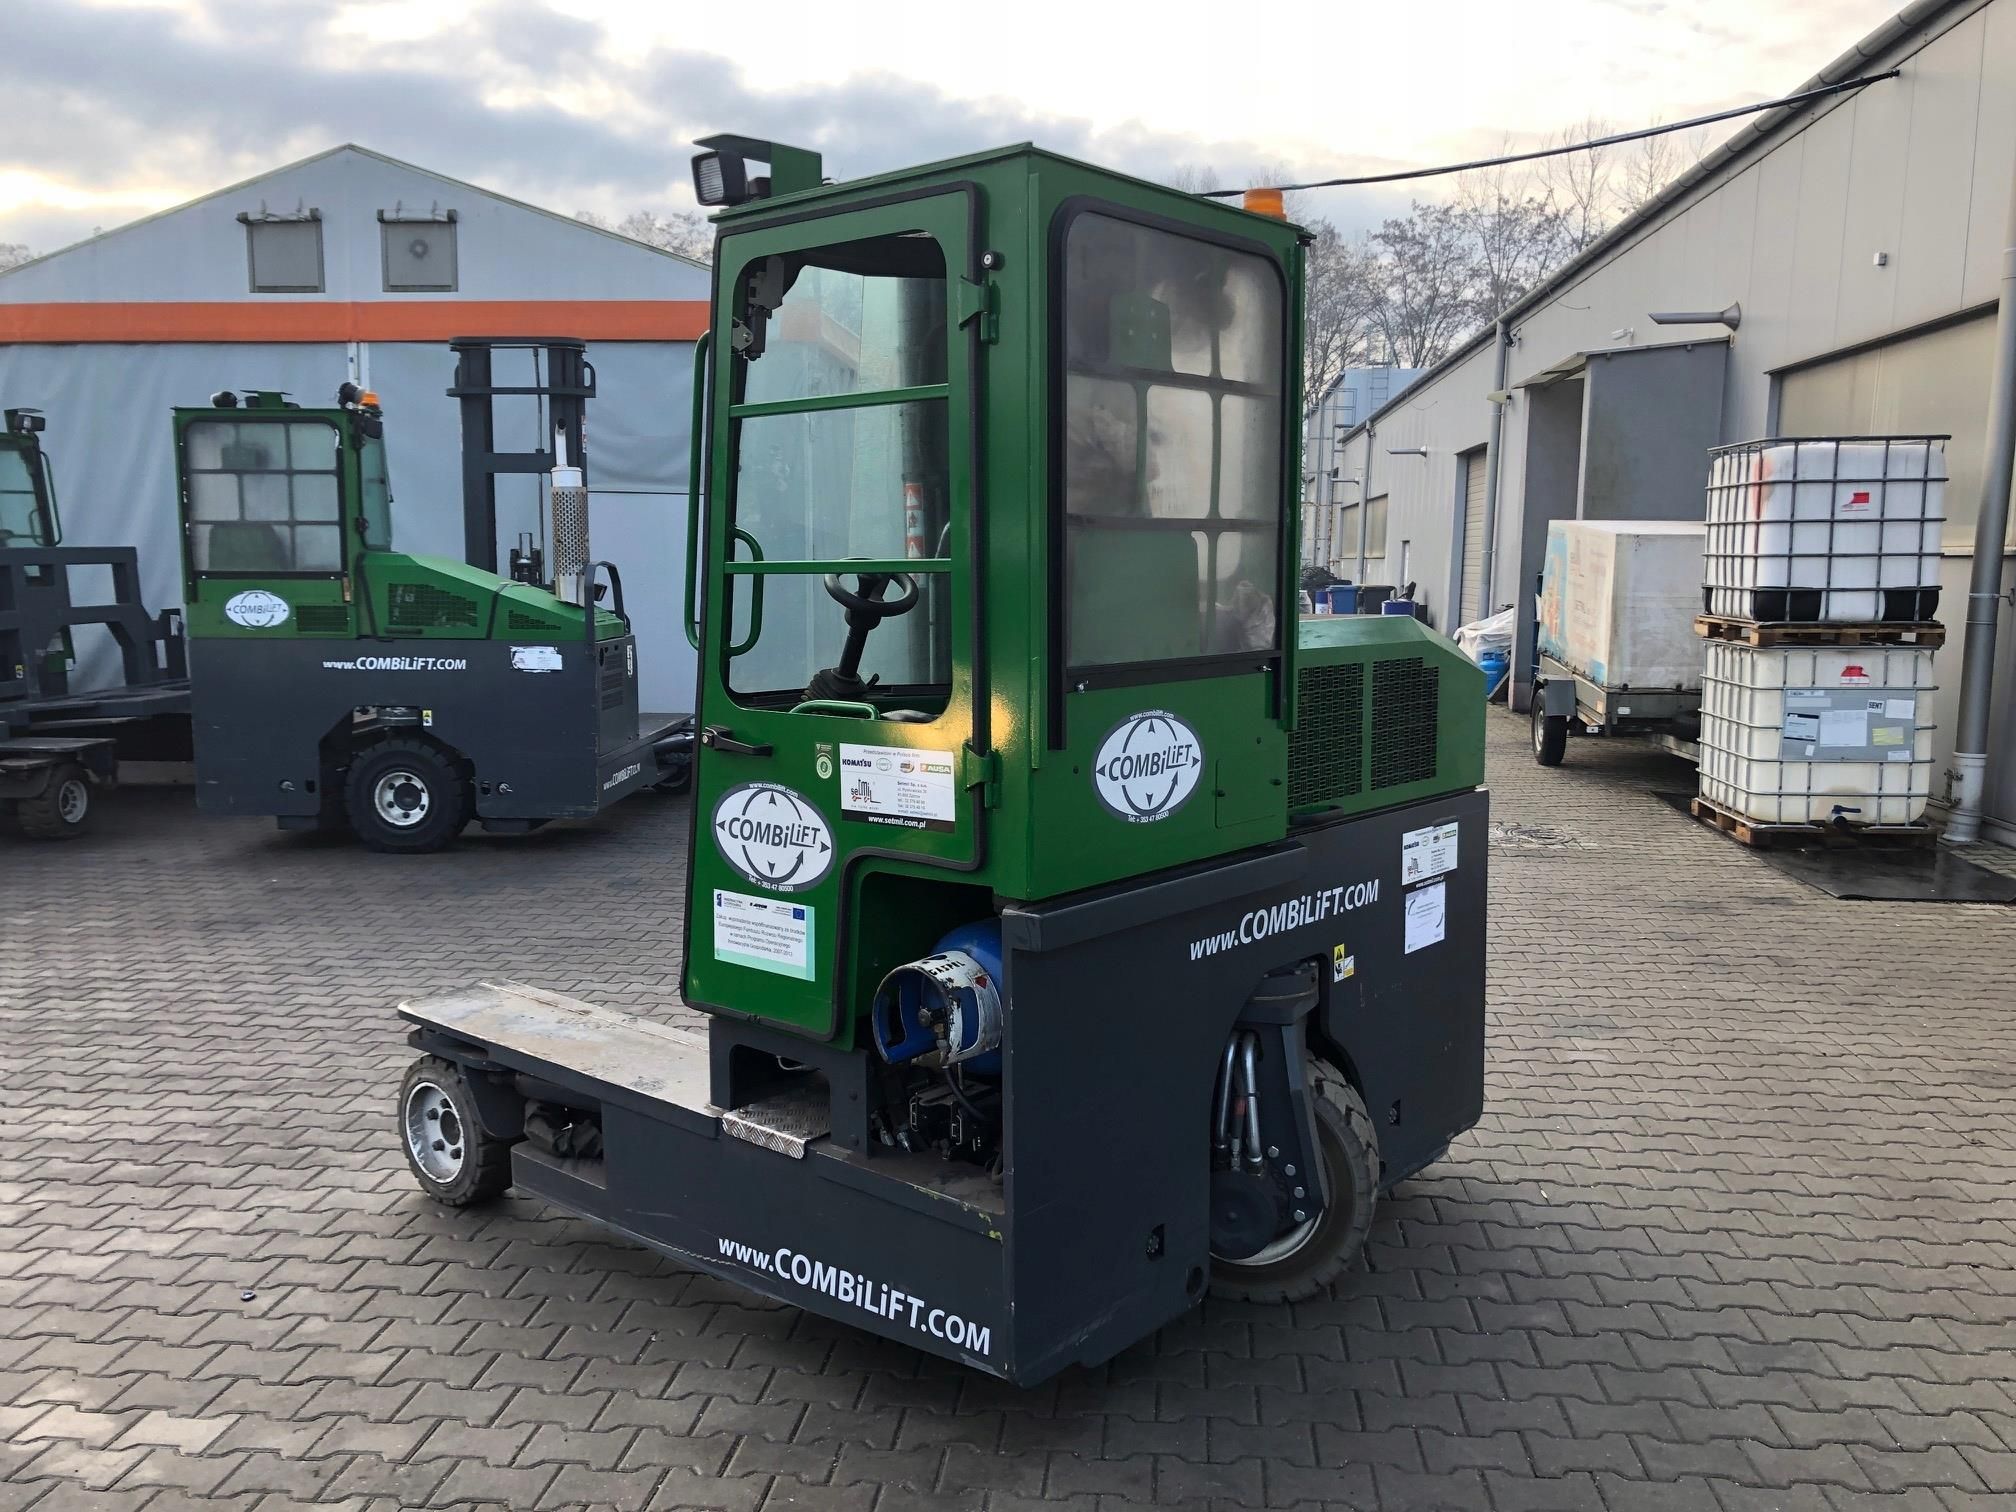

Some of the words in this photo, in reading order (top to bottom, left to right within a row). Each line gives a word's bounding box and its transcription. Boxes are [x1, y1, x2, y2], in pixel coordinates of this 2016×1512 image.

[323, 657, 466, 671] www.COMBiLiFT.COM
[1868, 701, 1883, 710] SENT
[1130, 710, 1175, 721] www.combilift.com
[842, 758, 872, 768] KOMATSU
[927, 764, 951, 773] AUSA
[1109, 744, 1192, 781] COMBiLiFT
[749, 783, 798, 798] www.combilift.com
[868, 816, 926, 829] www.setmil.com.pl
[728, 817, 821, 848] COMBiLiFT
[1190, 879, 1380, 961] www.COMBiLiFT.COM
[718, 1238, 991, 1356] www.COMBiLiFT.COM
